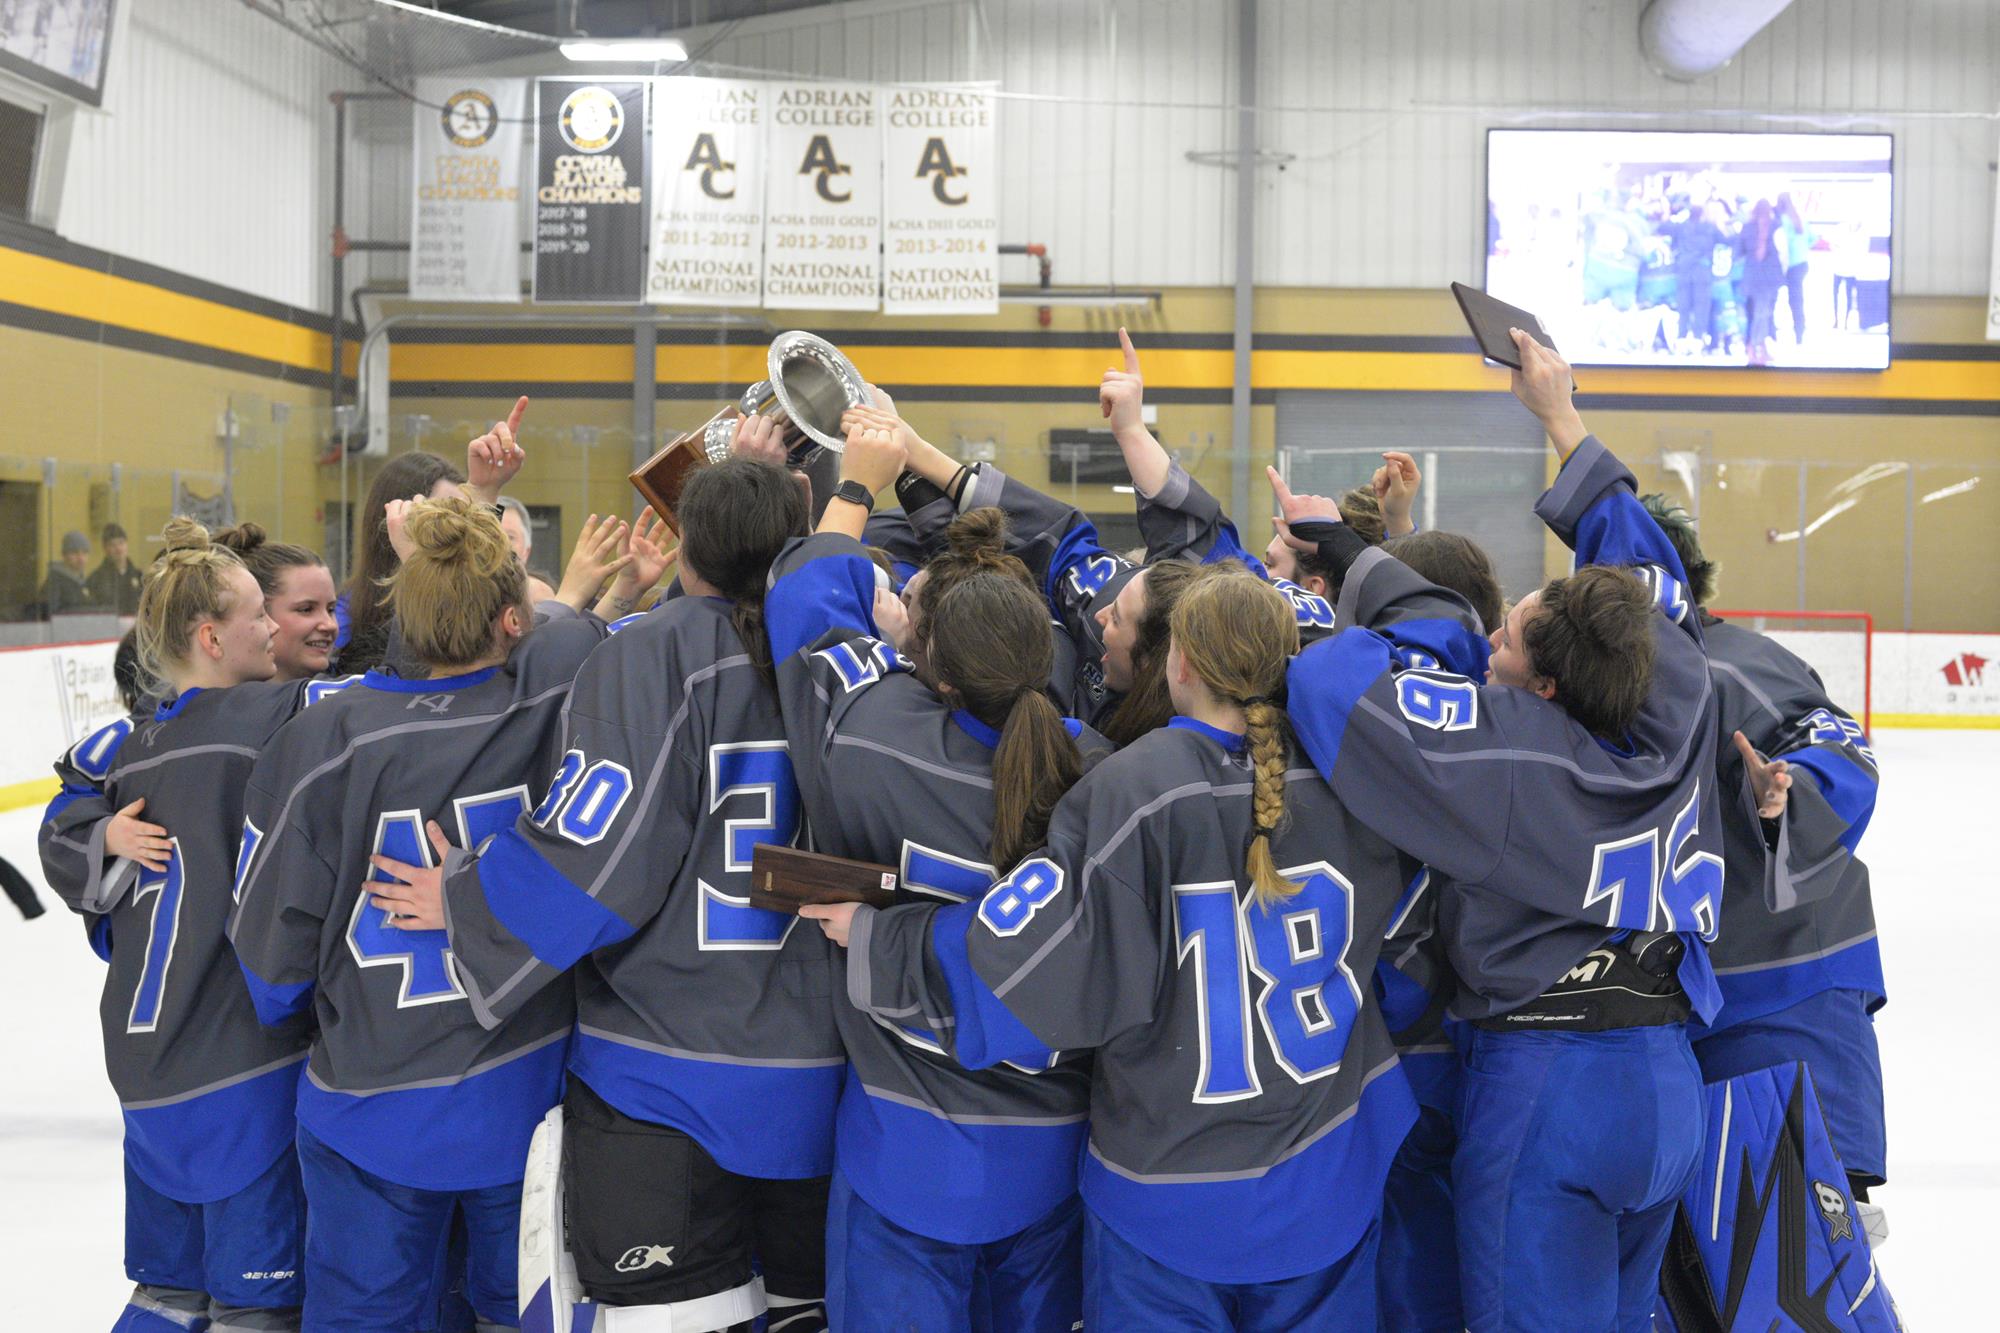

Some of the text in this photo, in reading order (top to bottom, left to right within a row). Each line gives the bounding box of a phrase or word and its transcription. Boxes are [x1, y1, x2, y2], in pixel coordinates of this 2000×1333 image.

[778, 89, 873, 107] ADRIAN
[890, 92, 986, 109] ADRIAN
[775, 109, 875, 127] COLLEGE
[889, 110, 989, 128] COLLEGE
[538, 186, 642, 204] CHAMPIONS
[770, 214, 811, 226] ACHA
[841, 215, 877, 227] GOLD
[956, 218, 996, 230] GOLD
[661, 231, 751, 247] 2011-2012
[777, 233, 868, 250] 2012-2013
[895, 238, 987, 255] 2013-2014
[654, 258, 755, 276] NATIONAL
[769, 262, 875, 281] NATIONAL
[889, 267, 993, 284] NATIONAL
[650, 275, 759, 296] CHAMPIONS
[767, 280, 876, 298] CHAMPIONS
[887, 284, 995, 302] CHAMPIONS
[1582, 777, 1725, 943] 16
[1171, 860, 1364, 1105] 18
